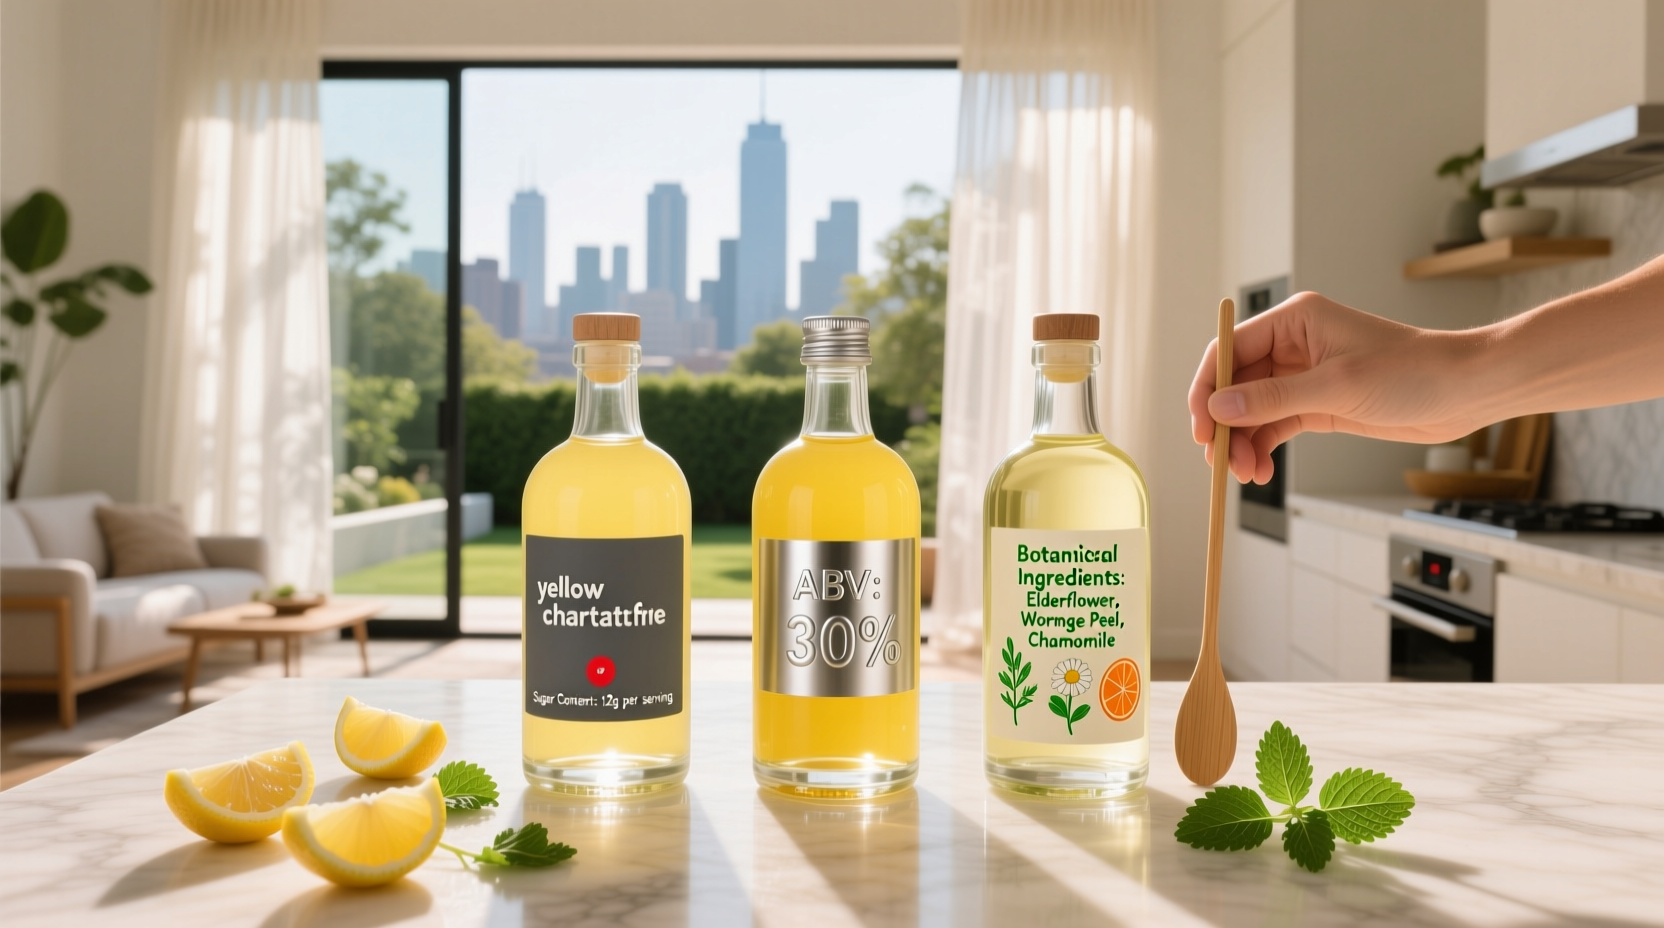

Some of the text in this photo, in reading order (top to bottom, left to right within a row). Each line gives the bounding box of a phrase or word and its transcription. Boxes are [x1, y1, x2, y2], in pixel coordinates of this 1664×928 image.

[537, 575, 604, 604] yellow
[793, 569, 880, 600] ABV:
[1019, 568, 1124, 591] Ingredients:
[1027, 591, 1119, 608] Elderflower,
[1090, 611, 1124, 628] Peel,
[786, 614, 902, 668] 30%
[1029, 631, 1115, 648] Chamomile
[601, 694, 618, 709] 12g
[622, 695, 637, 709] per
